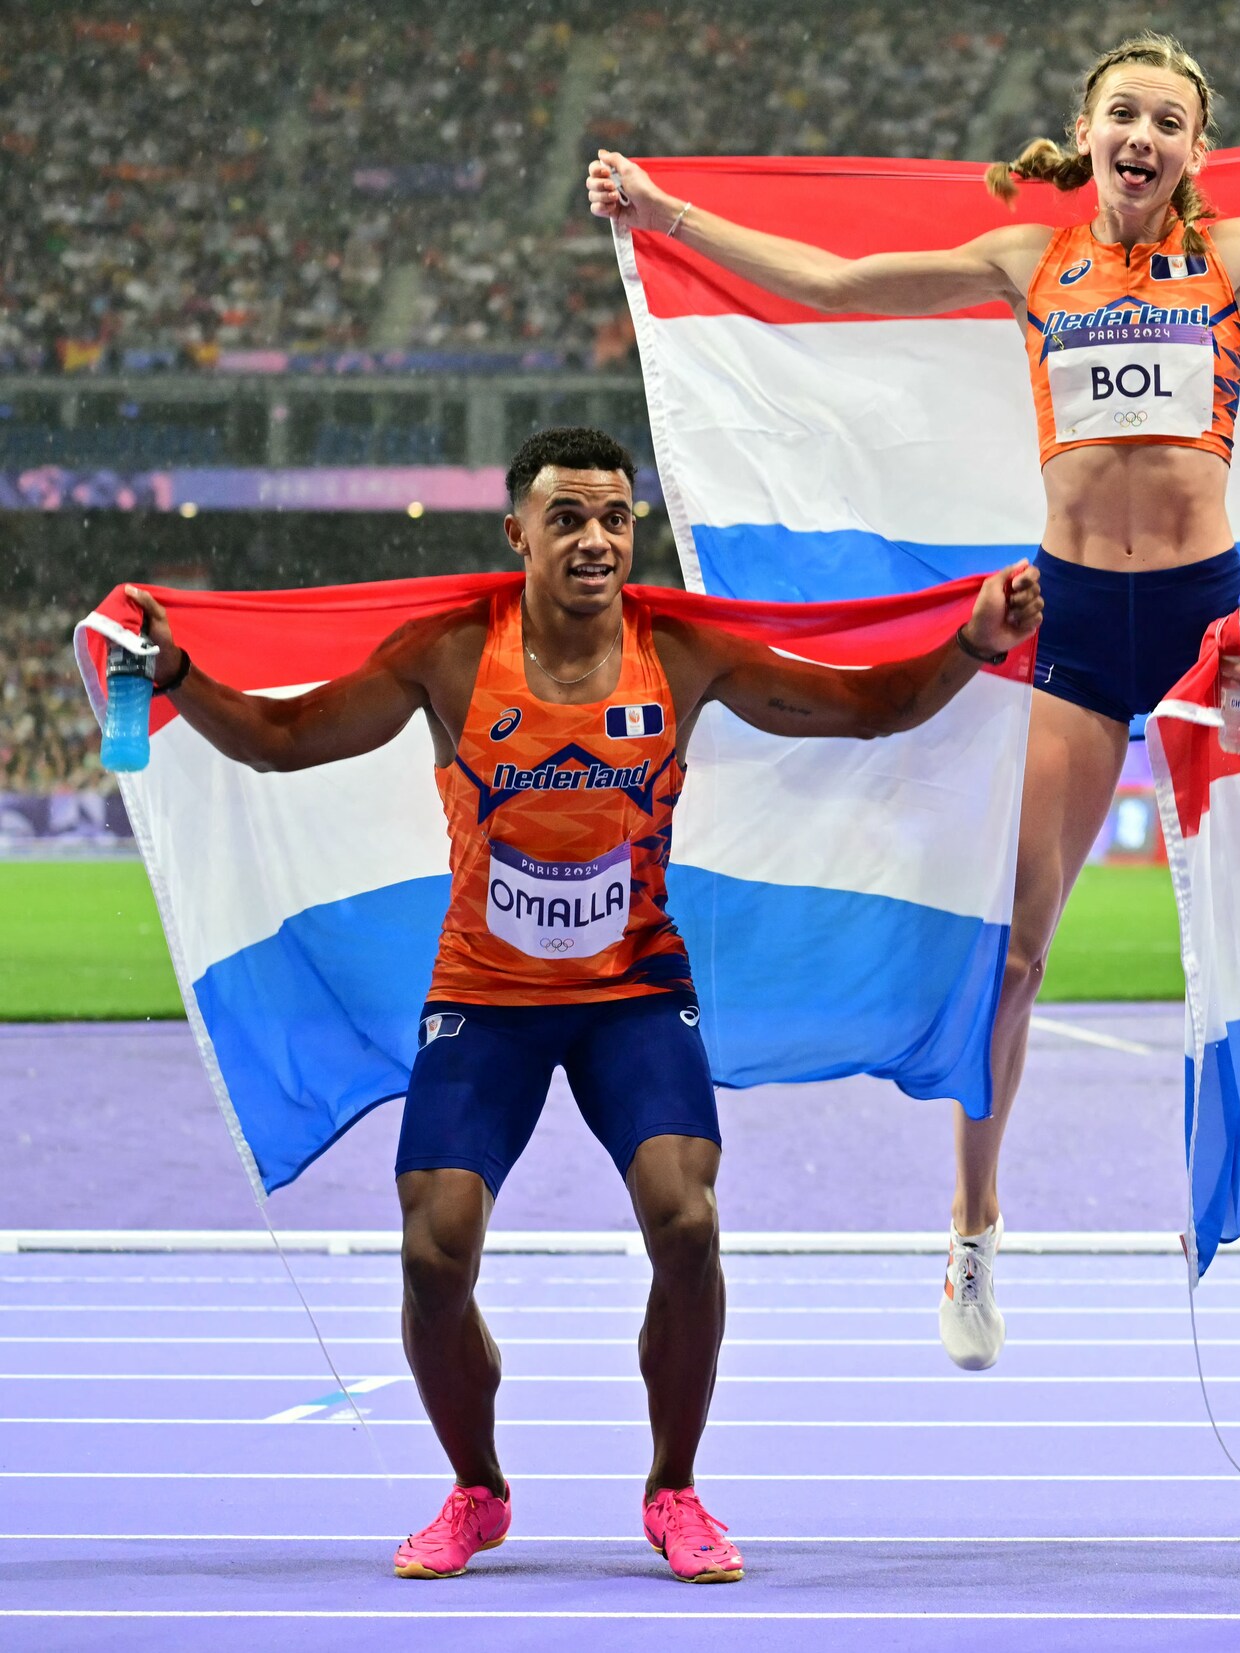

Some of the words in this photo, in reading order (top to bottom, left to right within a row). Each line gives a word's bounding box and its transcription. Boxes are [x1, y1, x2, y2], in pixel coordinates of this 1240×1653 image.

[1042, 303, 1210, 336] Nederland
[1089, 329, 1129, 341] PARIS
[1134, 328, 1171, 339] 2024
[1091, 364, 1173, 400] BOL
[492, 759, 651, 790] Nederland
[521, 858, 559, 876] PARIS
[564, 864, 599, 877] 2024
[490, 878, 624, 928] OMALLA
